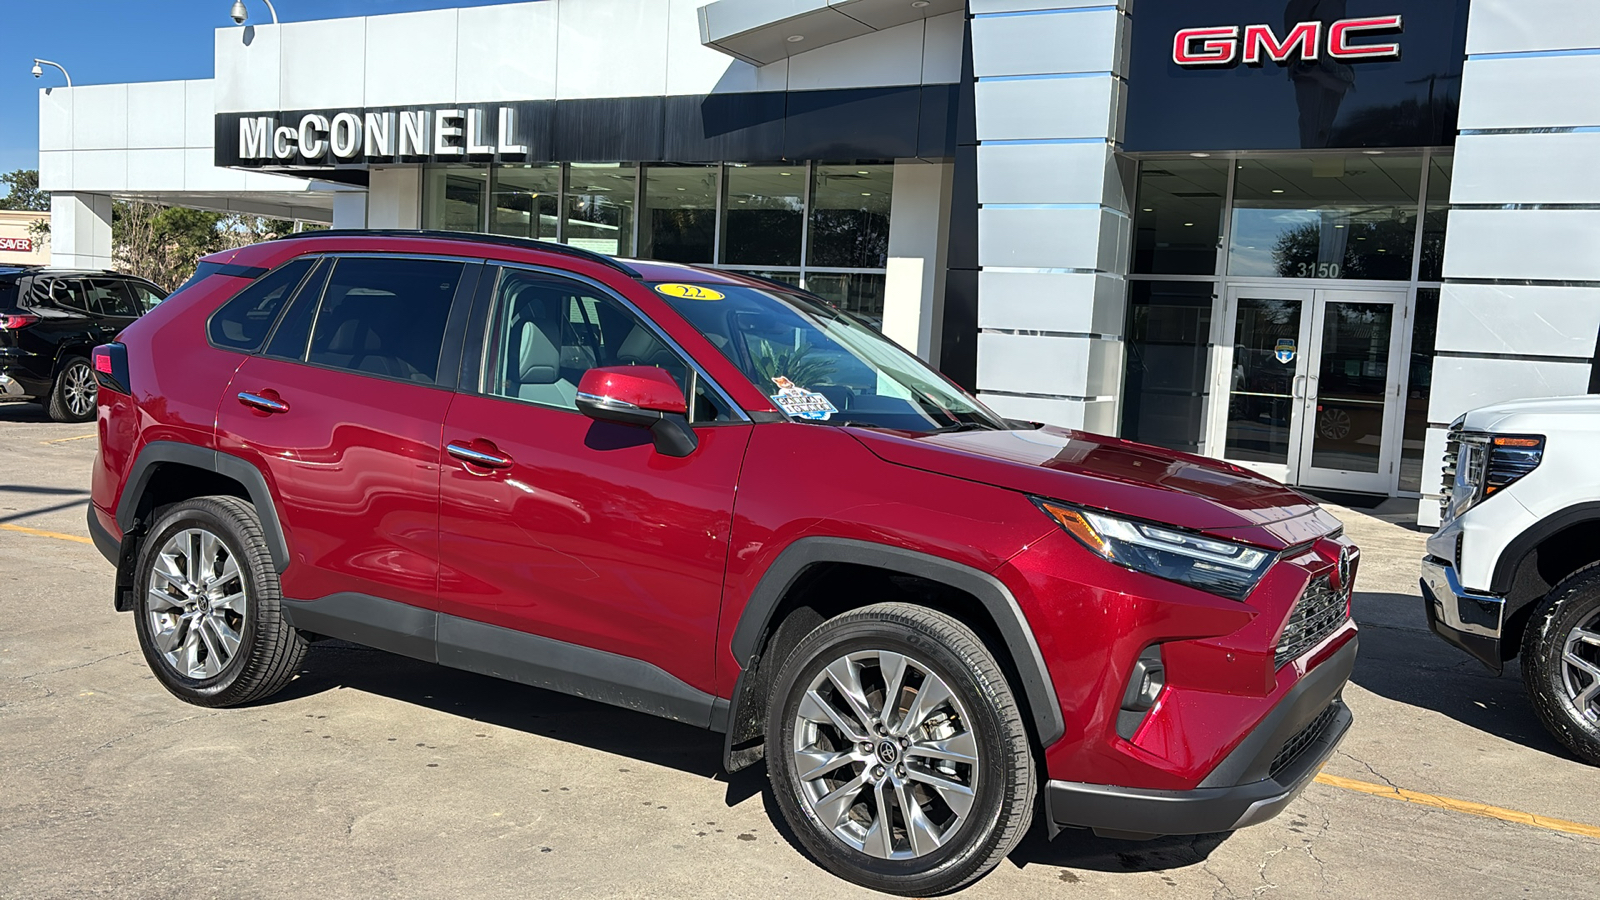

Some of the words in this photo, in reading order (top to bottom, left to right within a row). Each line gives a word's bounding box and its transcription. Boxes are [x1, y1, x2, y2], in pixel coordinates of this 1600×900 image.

[1173, 14, 1402, 65] GMC
[239, 107, 527, 158] McCONNELL
[0, 239, 30, 249] SAVER
[1297, 262, 1339, 278] 3150
[676, 286, 706, 298] 22
